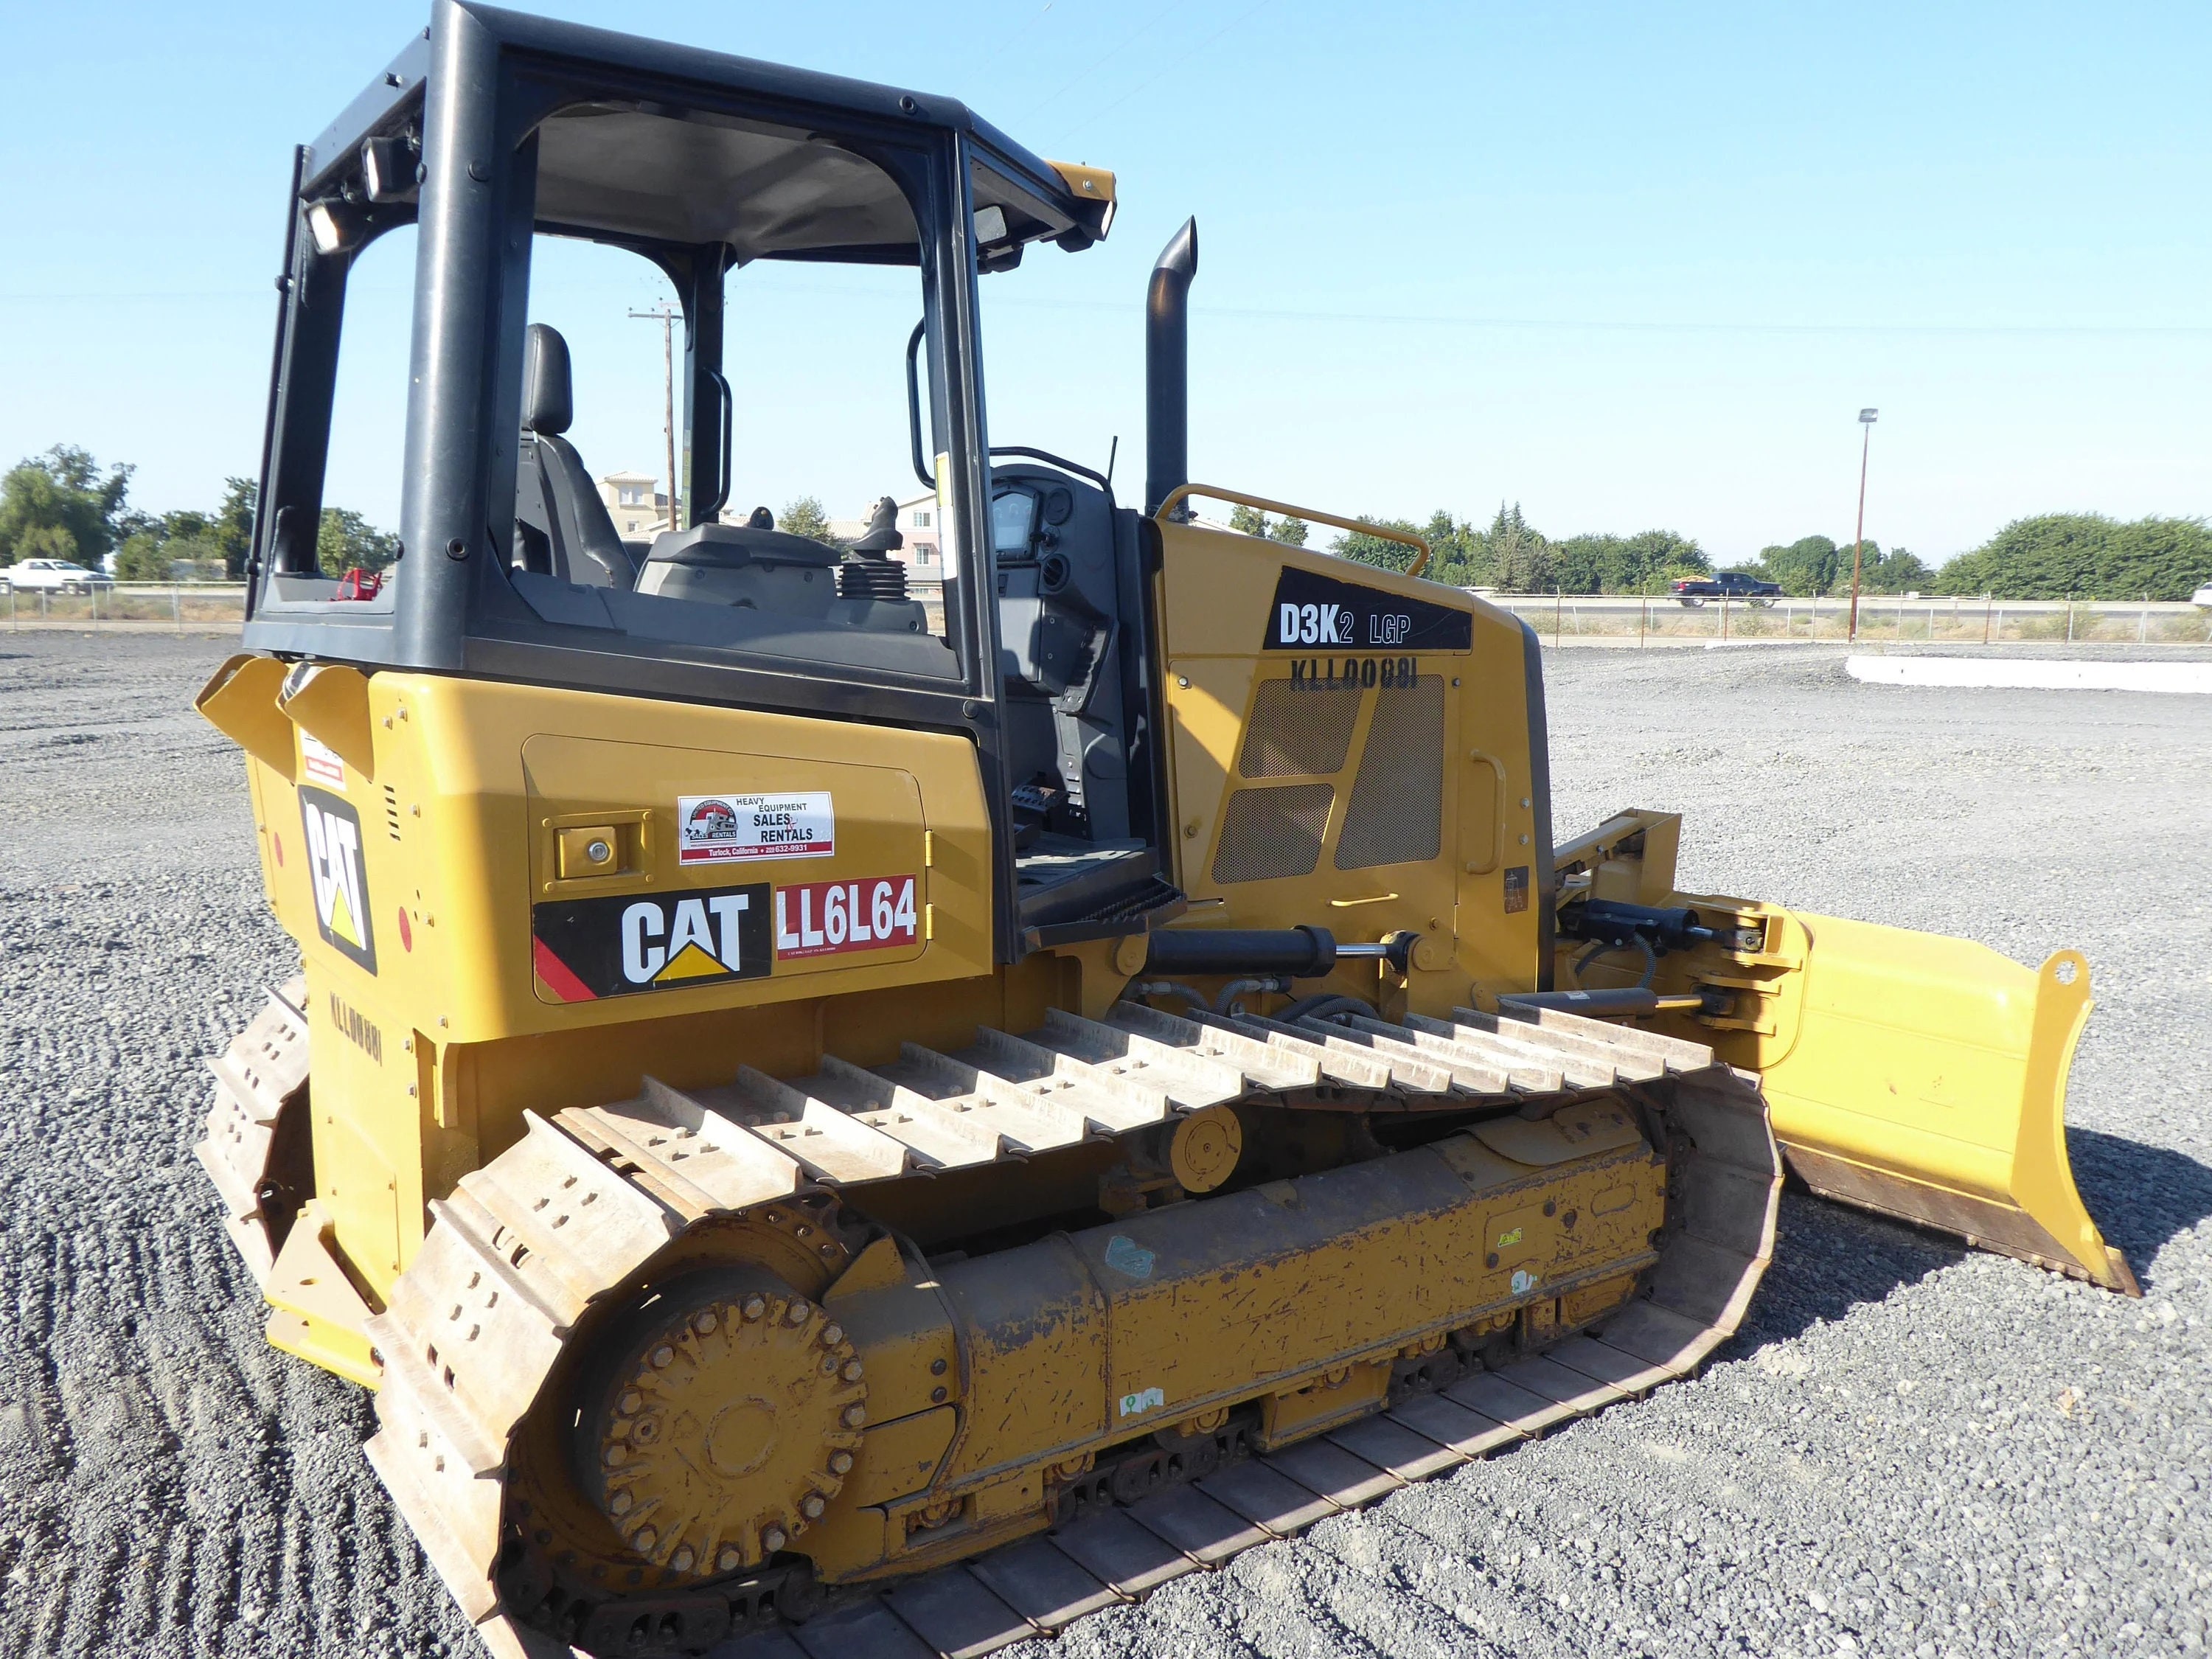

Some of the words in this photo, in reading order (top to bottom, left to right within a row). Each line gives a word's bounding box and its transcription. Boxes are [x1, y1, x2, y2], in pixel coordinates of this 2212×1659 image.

[1369, 613, 1411, 644] LGP
[704, 800, 728, 810] EQUIPMENT
[736, 797, 765, 806] HEAVY
[759, 803, 807, 813] EQUIPMENT
[754, 813, 790, 827] SALES
[761, 828, 813, 843] RENTALS
[709, 849, 731, 857] Turlock,
[732, 846, 758, 856] California
[775, 844, 807, 853] 632-9931
[305, 803, 366, 950] CAT
[776, 878, 917, 950] LL6L64
[622, 894, 748, 983] CAT
